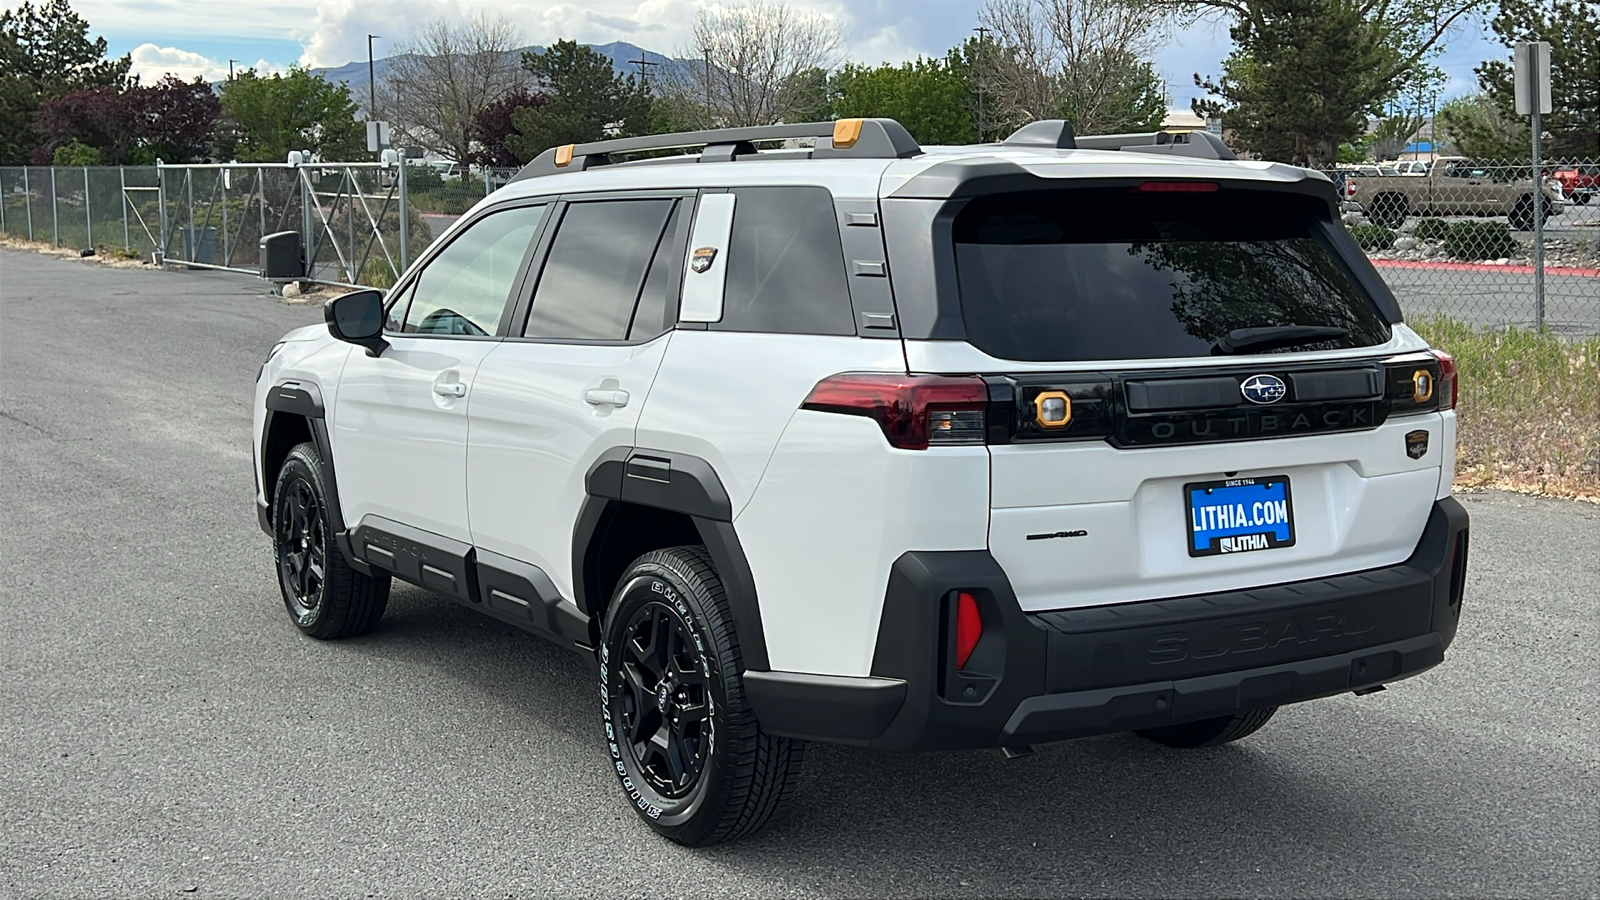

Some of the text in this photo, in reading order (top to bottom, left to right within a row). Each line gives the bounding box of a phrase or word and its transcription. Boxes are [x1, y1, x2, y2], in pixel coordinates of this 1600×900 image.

[1152, 408, 1368, 439] OUTBACK
[1225, 480, 1242, 488] SINCE
[1192, 499, 1289, 532] LITHIA.COM
[1230, 534, 1270, 552] LITHIA
[601, 642, 664, 820] BRIDGESTONE
